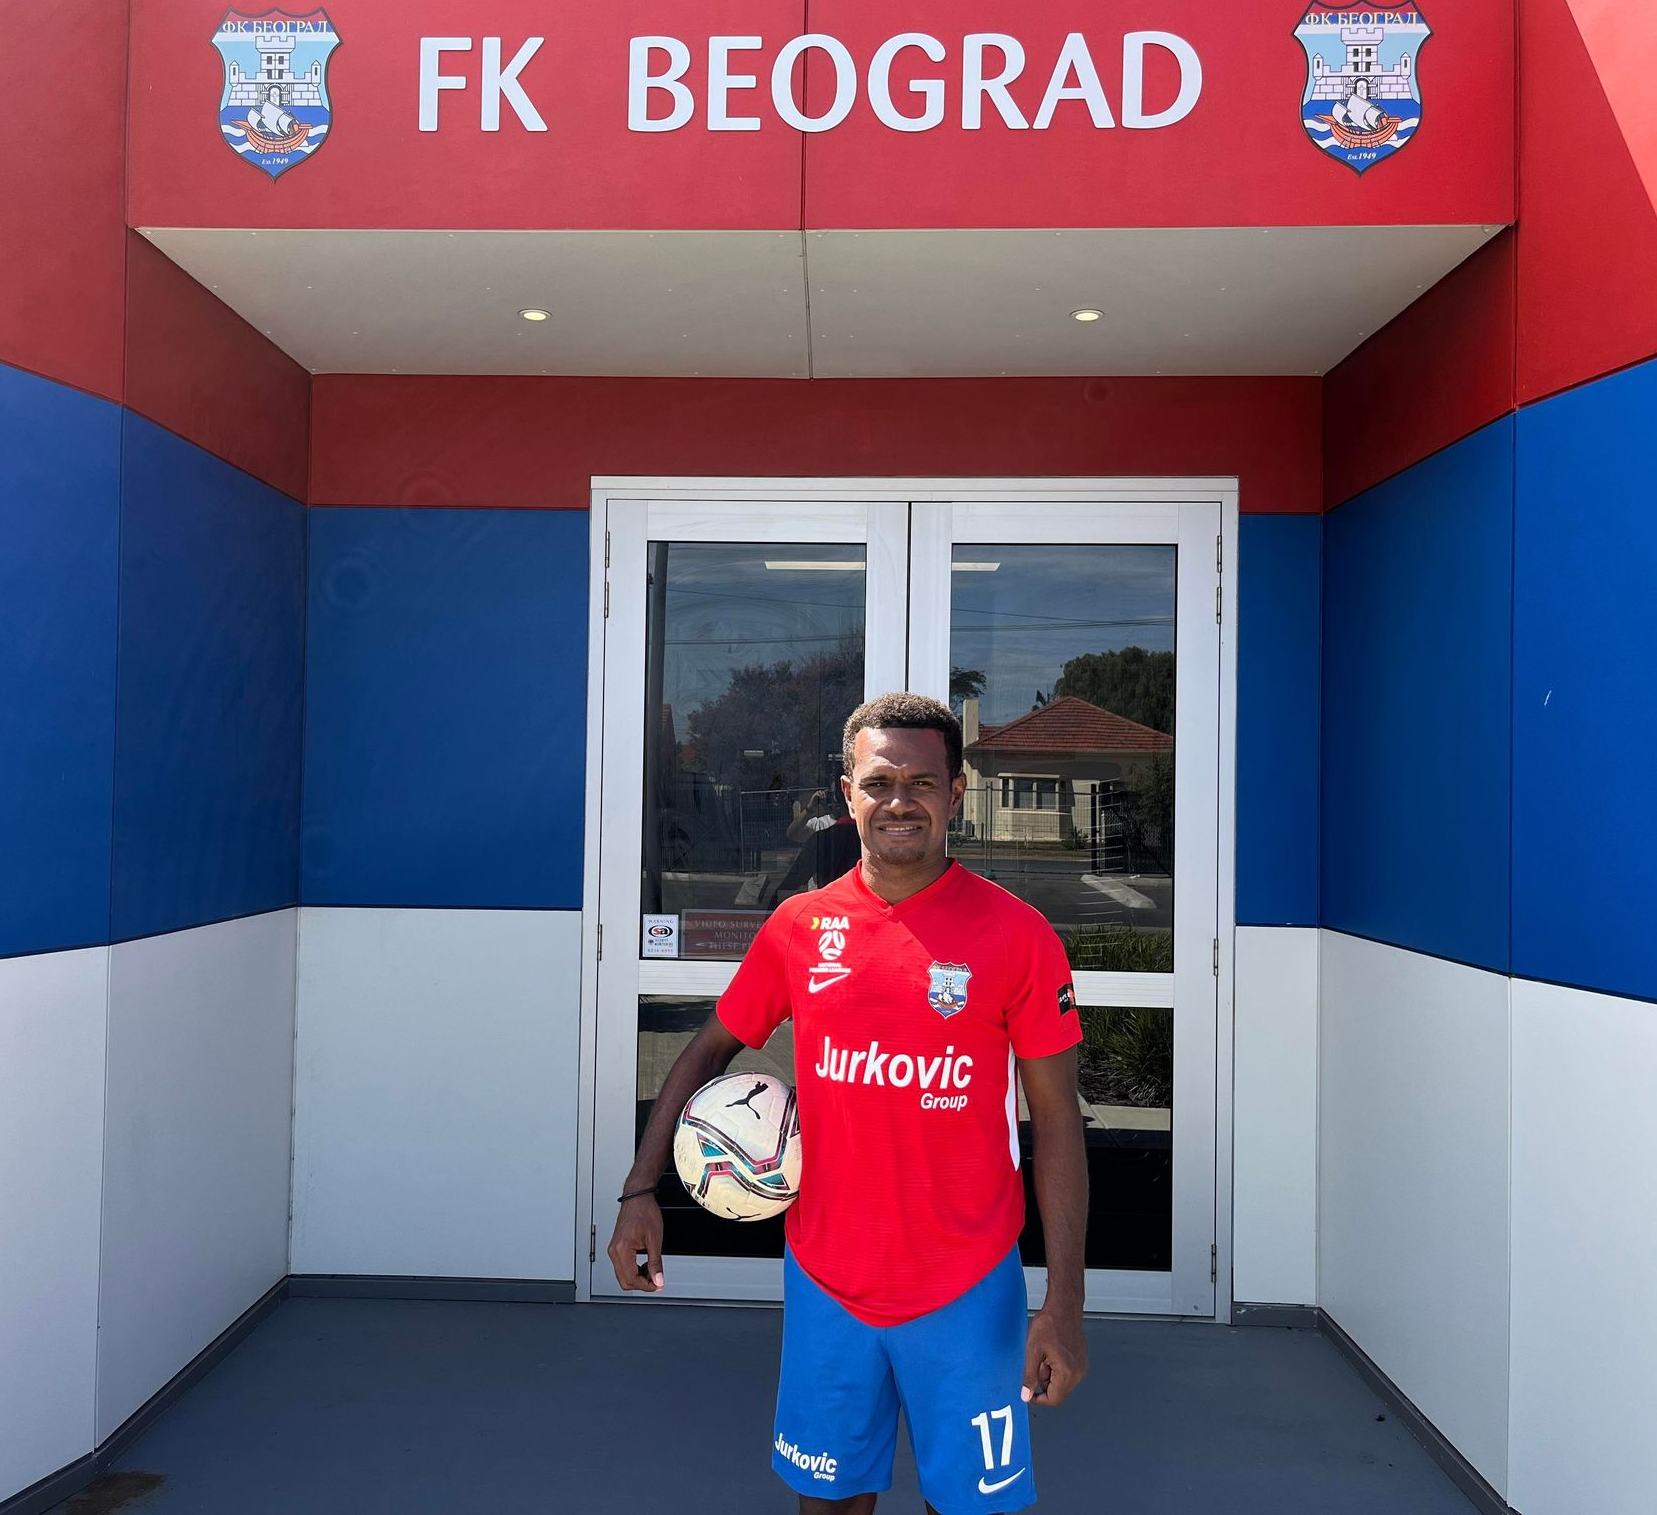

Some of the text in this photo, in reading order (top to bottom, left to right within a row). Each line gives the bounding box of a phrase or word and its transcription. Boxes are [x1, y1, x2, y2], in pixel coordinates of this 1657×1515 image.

[222, 19, 329, 34] ФК БЕОГРАД
[1305, 11, 1418, 27] ФК БЕОГРАД
[418, 30, 1203, 132] FK BEOGRAD
[694, 920, 726, 929] VIDEO
[820, 916, 850, 930] RAA
[708, 941, 738, 951] THESE
[815, 1036, 974, 1089] Jurkovic
[920, 1092, 968, 1112] Group
[971, 1404, 1013, 1470] 17
[774, 1433, 838, 1474] Jurkovic
[813, 1471, 836, 1482] Group
